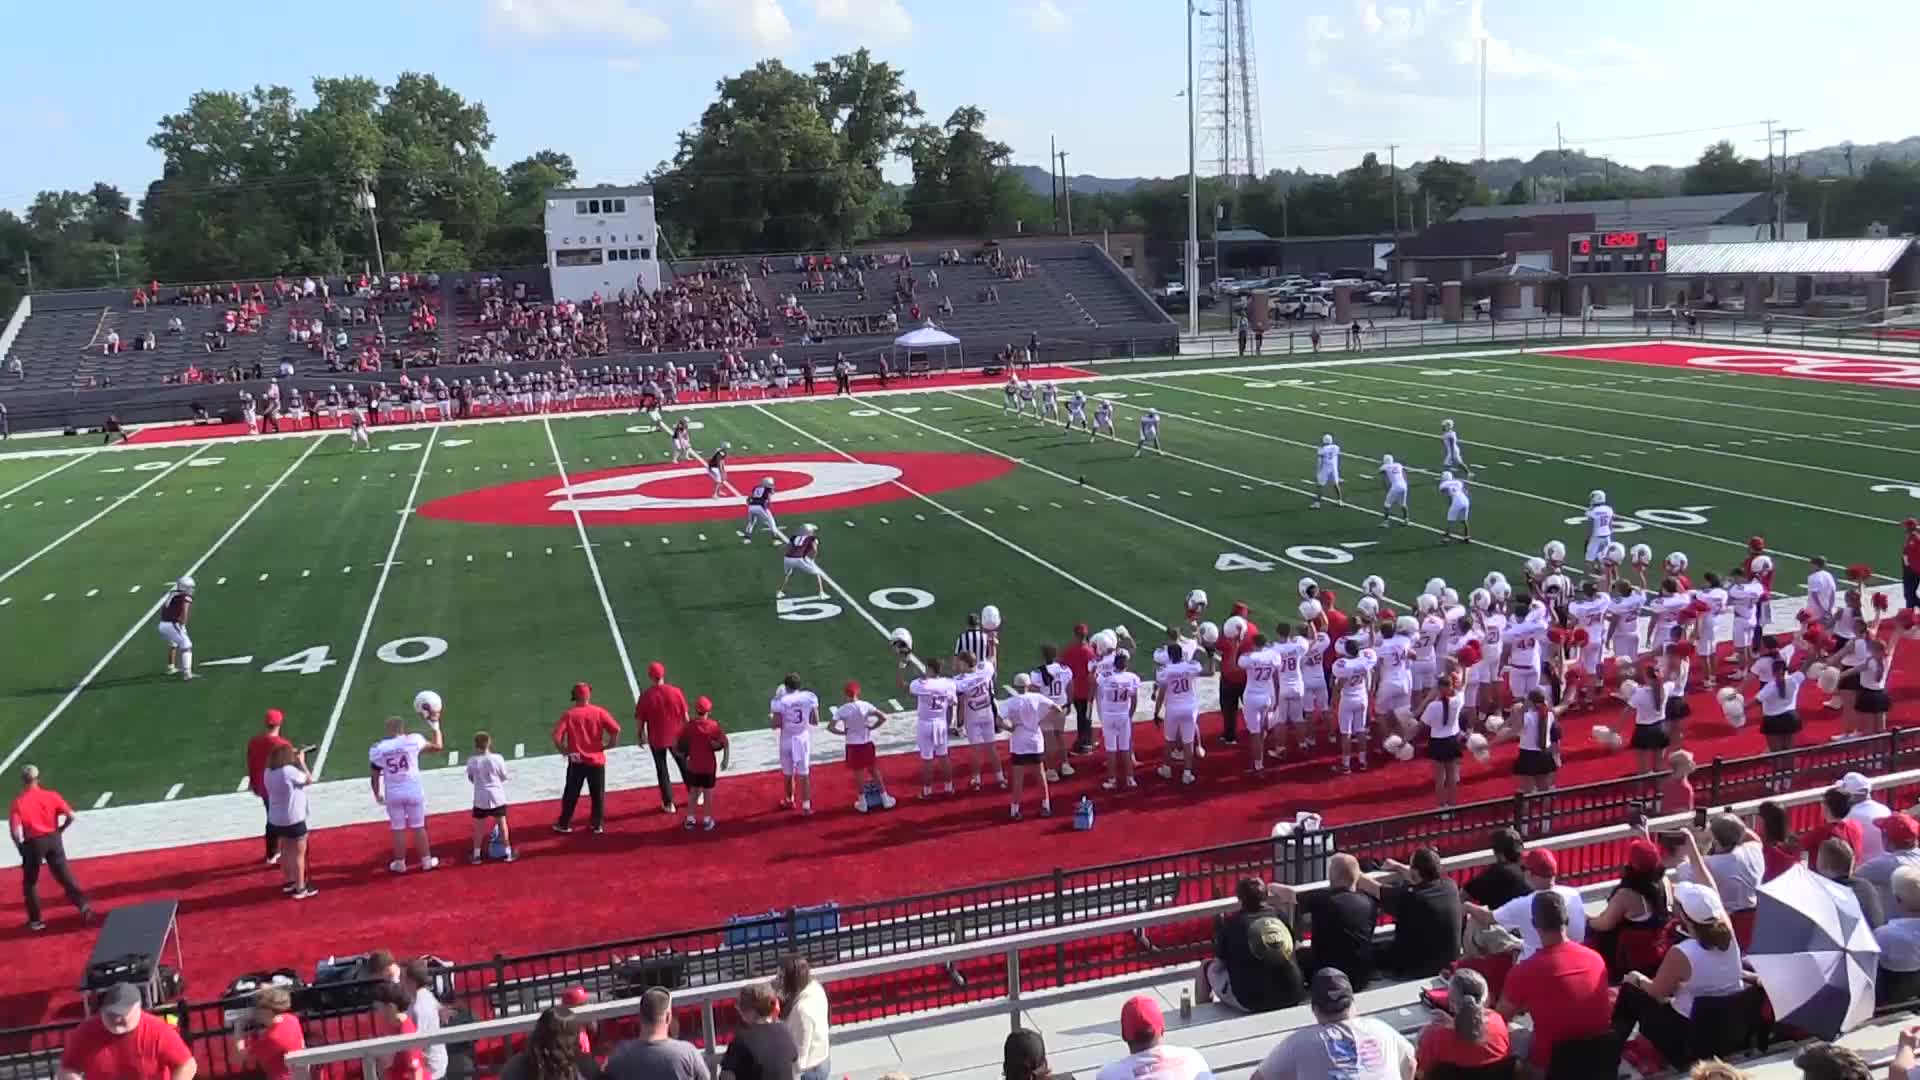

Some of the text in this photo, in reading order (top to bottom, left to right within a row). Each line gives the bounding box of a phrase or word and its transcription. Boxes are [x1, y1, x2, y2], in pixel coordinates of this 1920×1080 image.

[1580, 239, 1591, 254] 0
[1656, 237, 1666, 252] 0
[776, 587, 936, 621] 50
[261, 636, 448, 675] 40
[1281, 658, 1297, 673] 78
[1172, 679, 1189, 694] 20
[1113, 688, 1128, 702] 14
[792, 708, 803, 725] 3
[386, 755, 409, 774] 54
